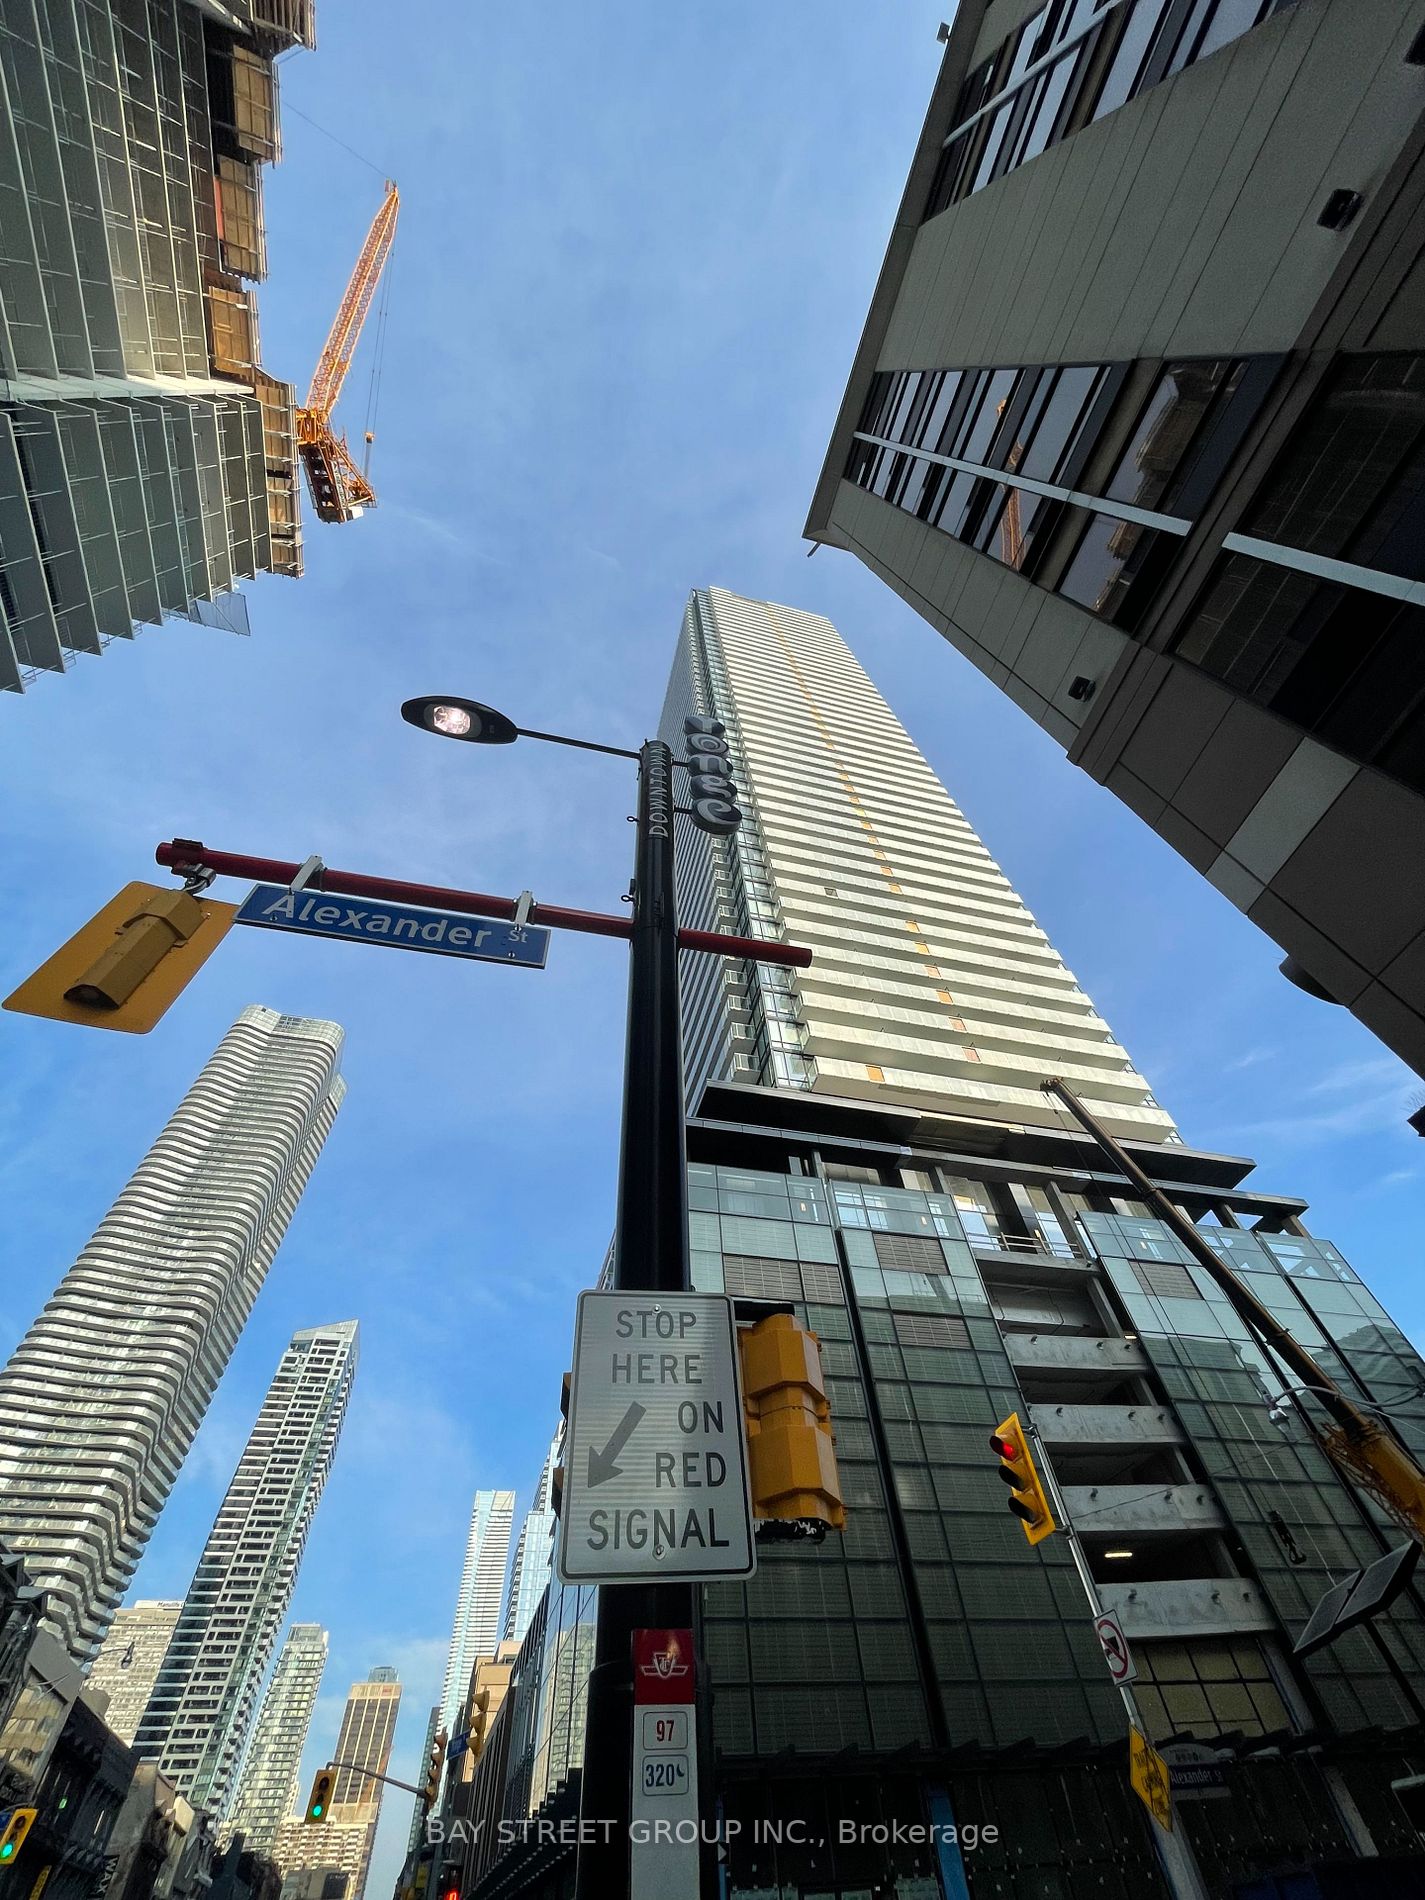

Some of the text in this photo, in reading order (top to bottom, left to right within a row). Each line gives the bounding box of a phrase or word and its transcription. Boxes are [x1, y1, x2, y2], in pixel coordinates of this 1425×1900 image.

[648, 744, 669, 838] DOWNTOWN
[262, 894, 528, 948] Alexander St
[615, 1310, 697, 1339] STOP
[612, 1353, 703, 1384] HERE
[678, 1401, 724, 1434] ON
[655, 1452, 727, 1488] RED
[586, 1507, 730, 1551] SIGNAL
[656, 1719, 675, 1742] 97
[645, 1763, 675, 1788] 320
